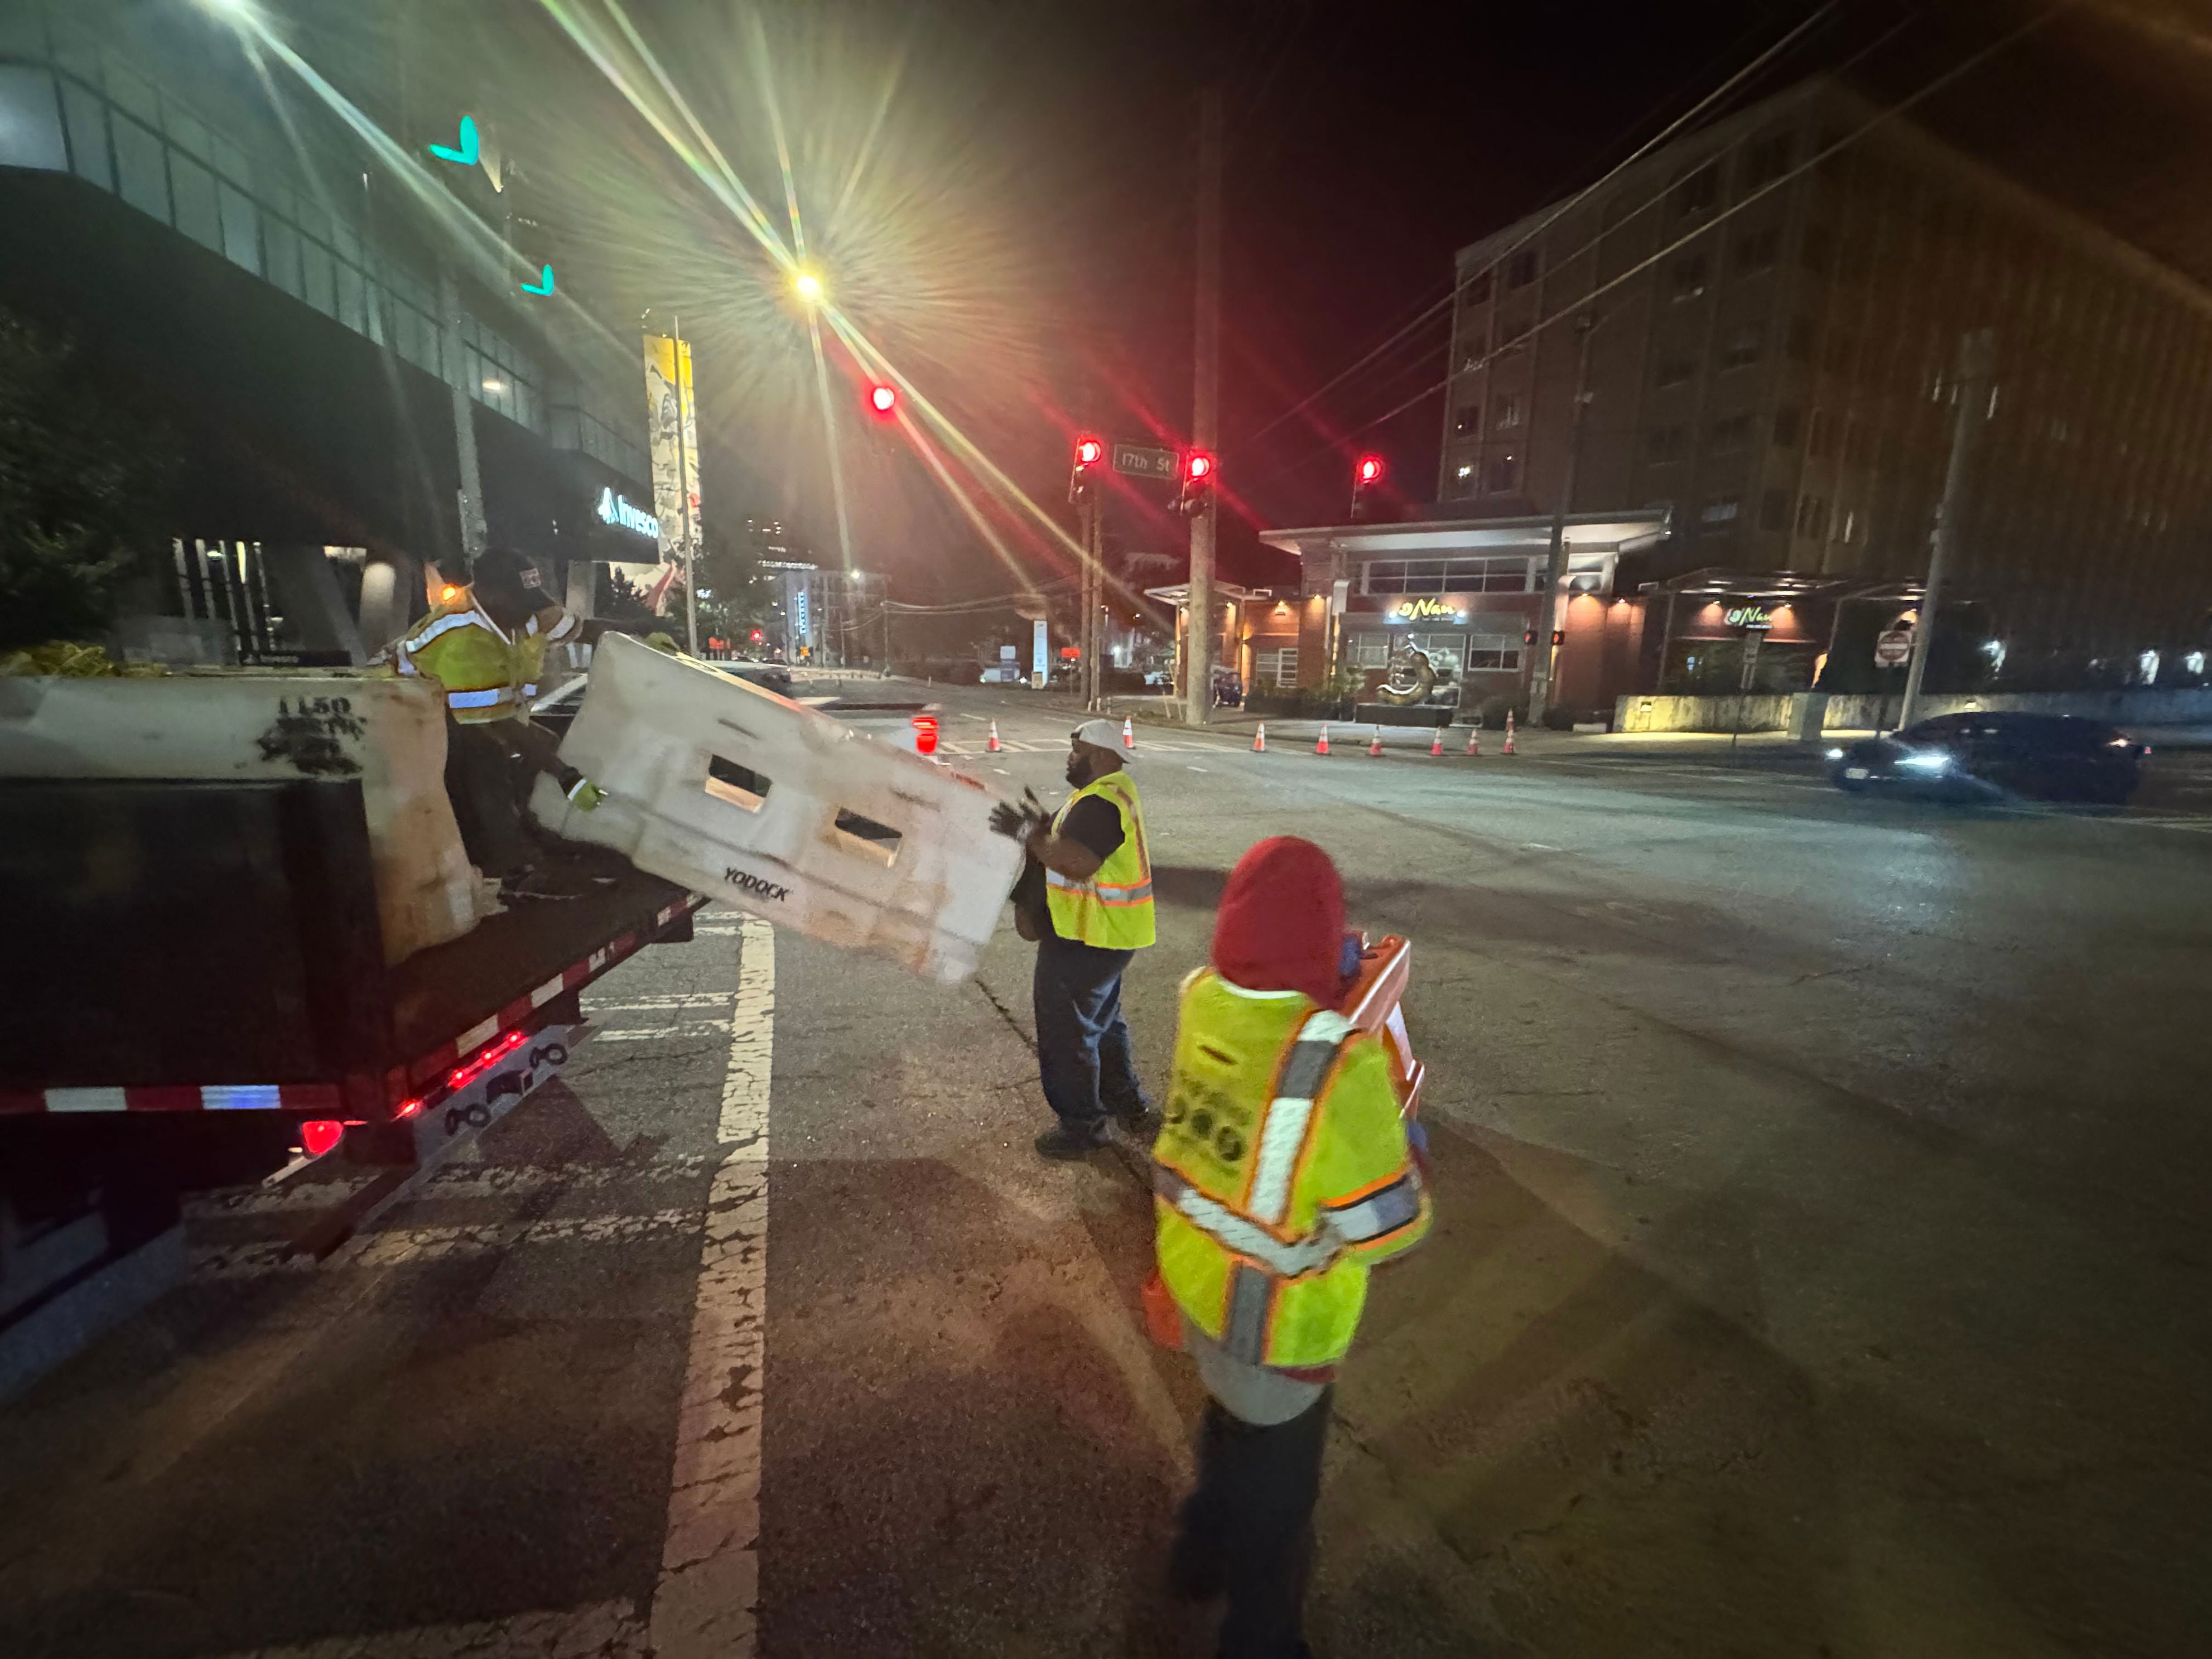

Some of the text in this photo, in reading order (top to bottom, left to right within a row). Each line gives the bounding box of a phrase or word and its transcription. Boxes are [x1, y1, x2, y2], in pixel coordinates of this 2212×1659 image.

[1122, 452, 1170, 472] 17th St
[618, 494, 659, 539] Invesco
[1409, 597, 1456, 620] Nan
[724, 866, 792, 902] YODOCK
